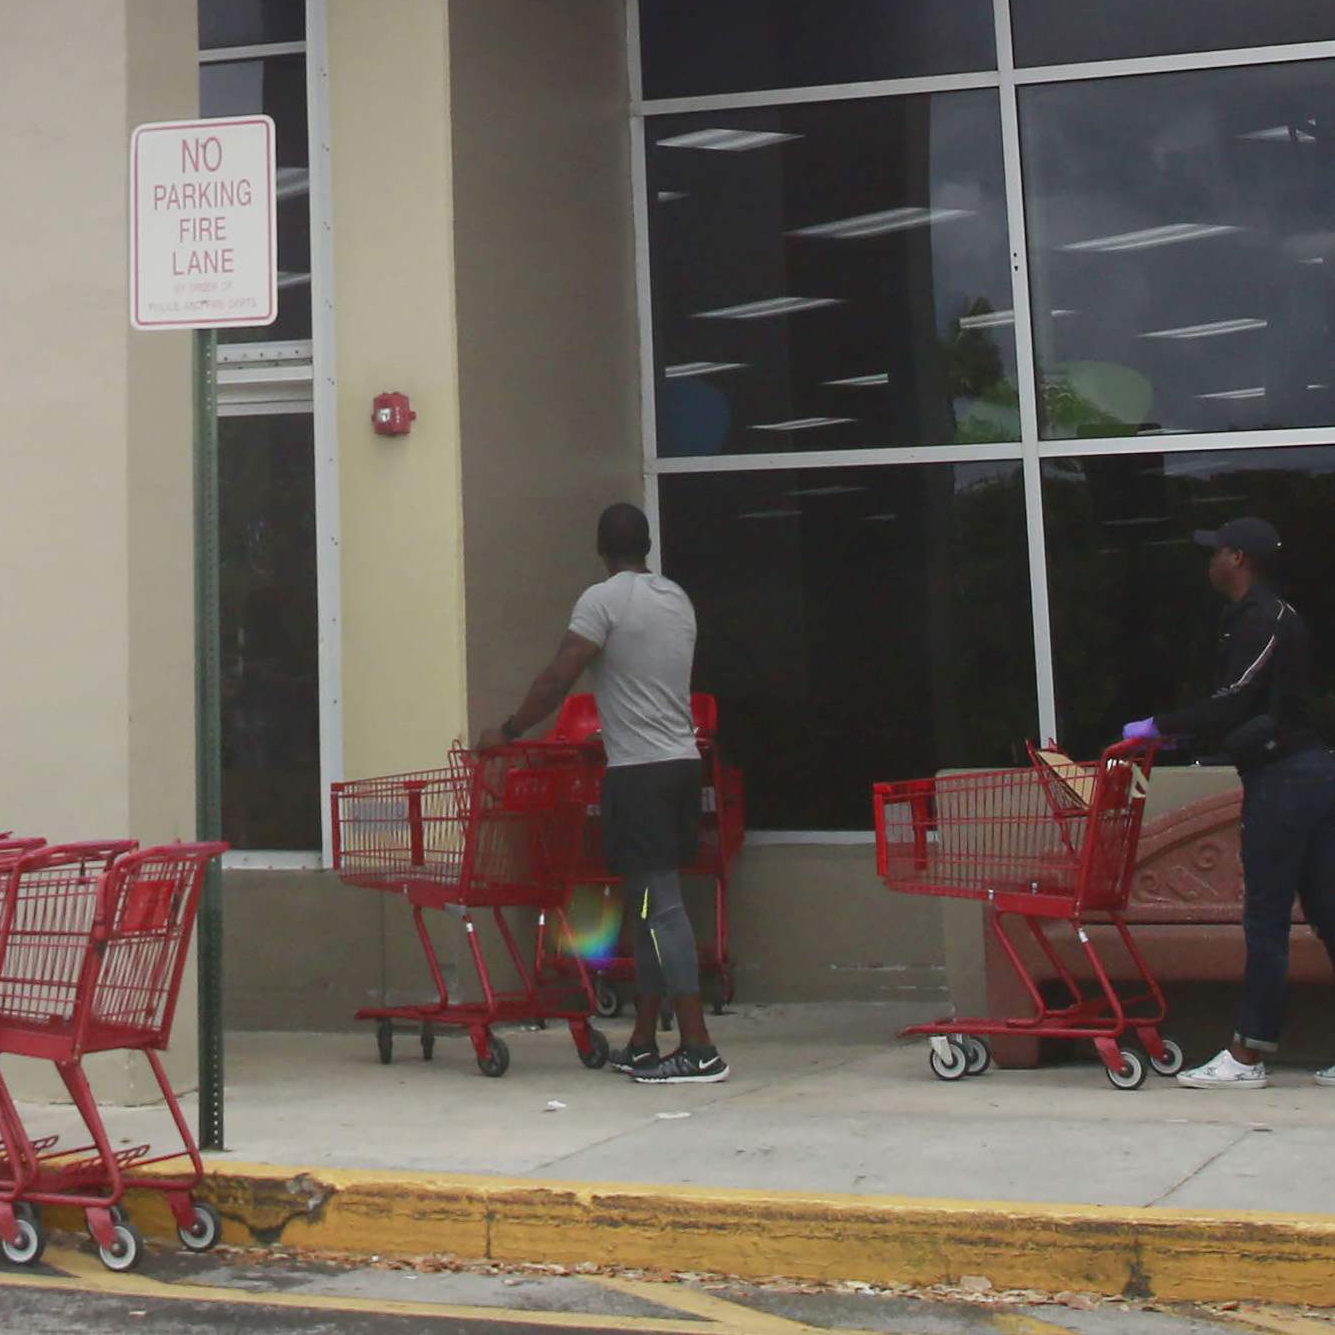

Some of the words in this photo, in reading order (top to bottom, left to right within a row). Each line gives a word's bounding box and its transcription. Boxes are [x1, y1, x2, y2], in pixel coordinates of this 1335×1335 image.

[181, 136, 223, 174] NO
[153, 178, 253, 212] PARKING
[179, 216, 227, 244] FIRE
[172, 248, 235, 276] LANE
